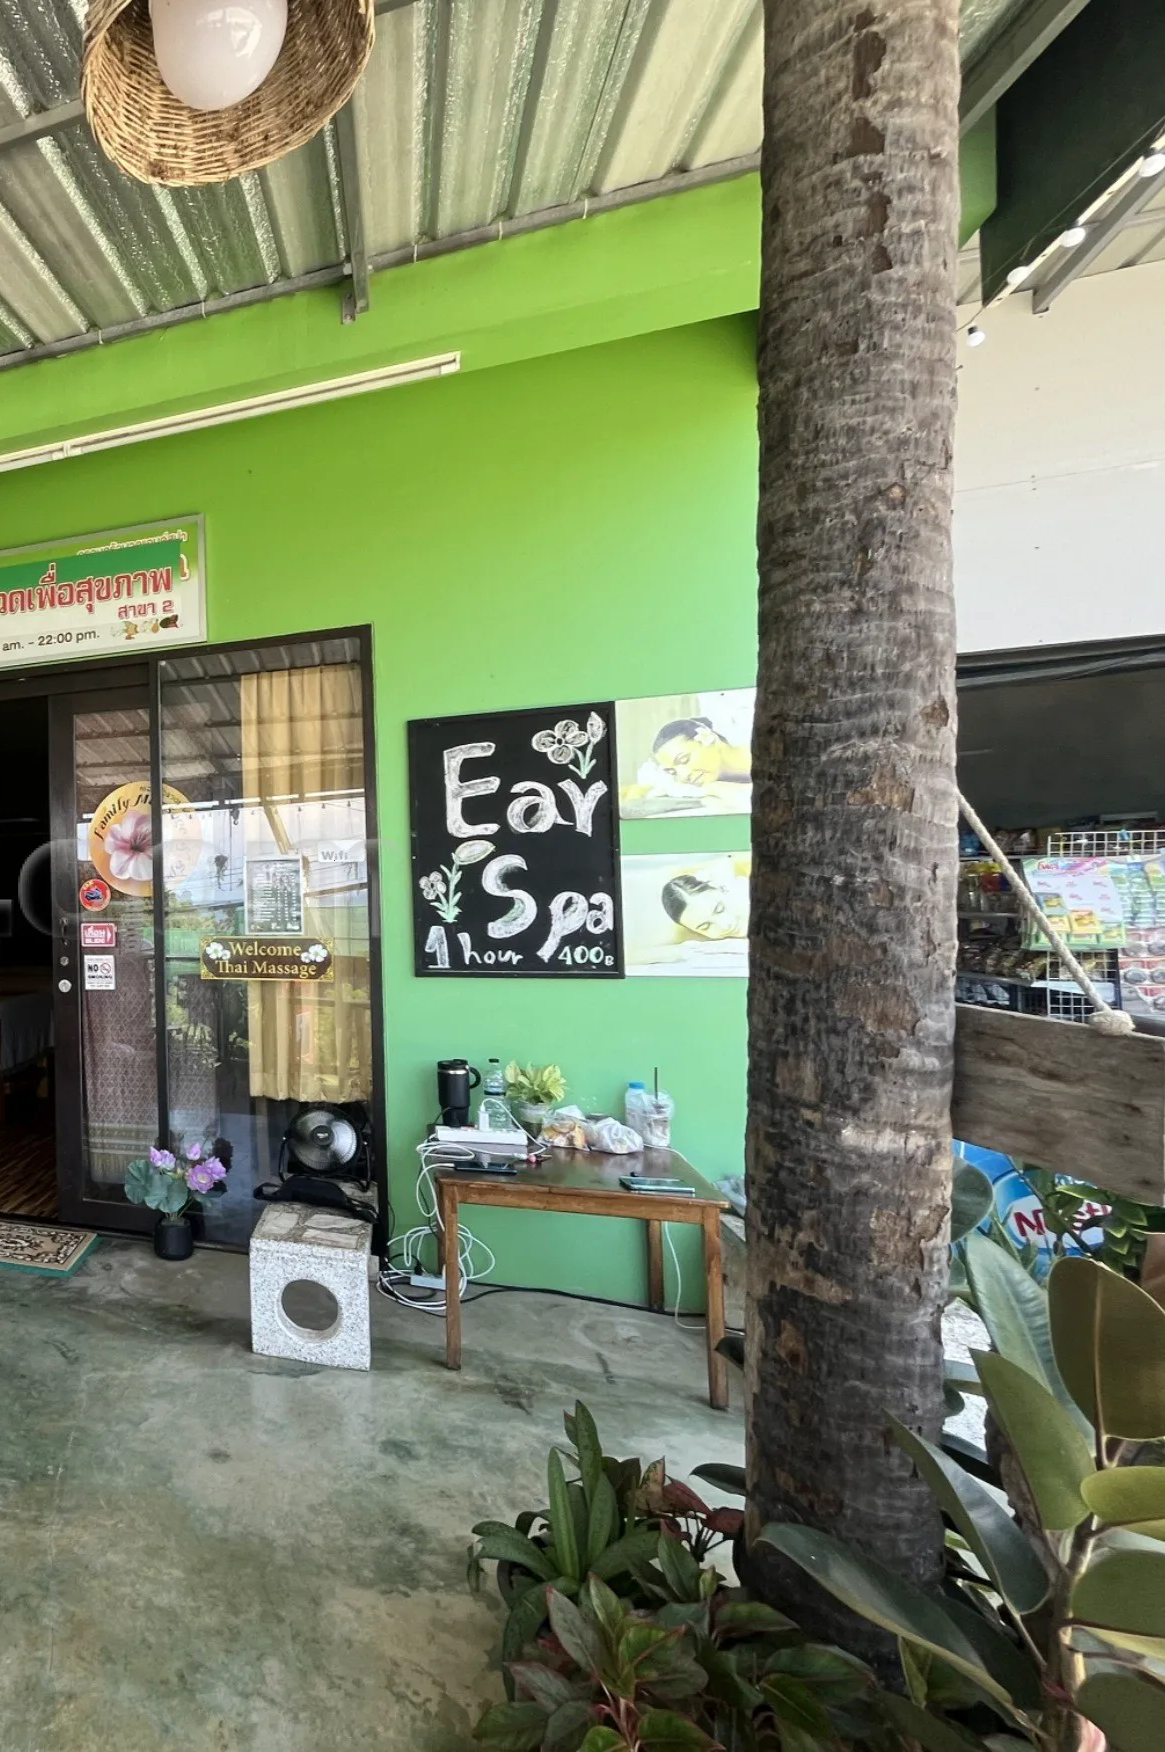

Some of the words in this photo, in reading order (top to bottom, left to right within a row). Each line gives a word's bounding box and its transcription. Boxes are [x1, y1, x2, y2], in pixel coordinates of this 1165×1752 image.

[117, 600, 157, 620] สาขา
[162, 600, 175, 614] 2
[2, 640, 25, 652] am.
[37, 631, 74, 648] 22:00
[75, 630, 101, 645] pm.
[443, 741, 608, 838] Ear
[481, 854, 615, 963] Spa
[229, 941, 301, 957] Welcome
[425, 925, 451, 968] 1
[457, 933, 523, 965] hour
[87, 964, 99, 972] NO
[217, 960, 248, 974] Thai
[252, 960, 317, 977] Massage
